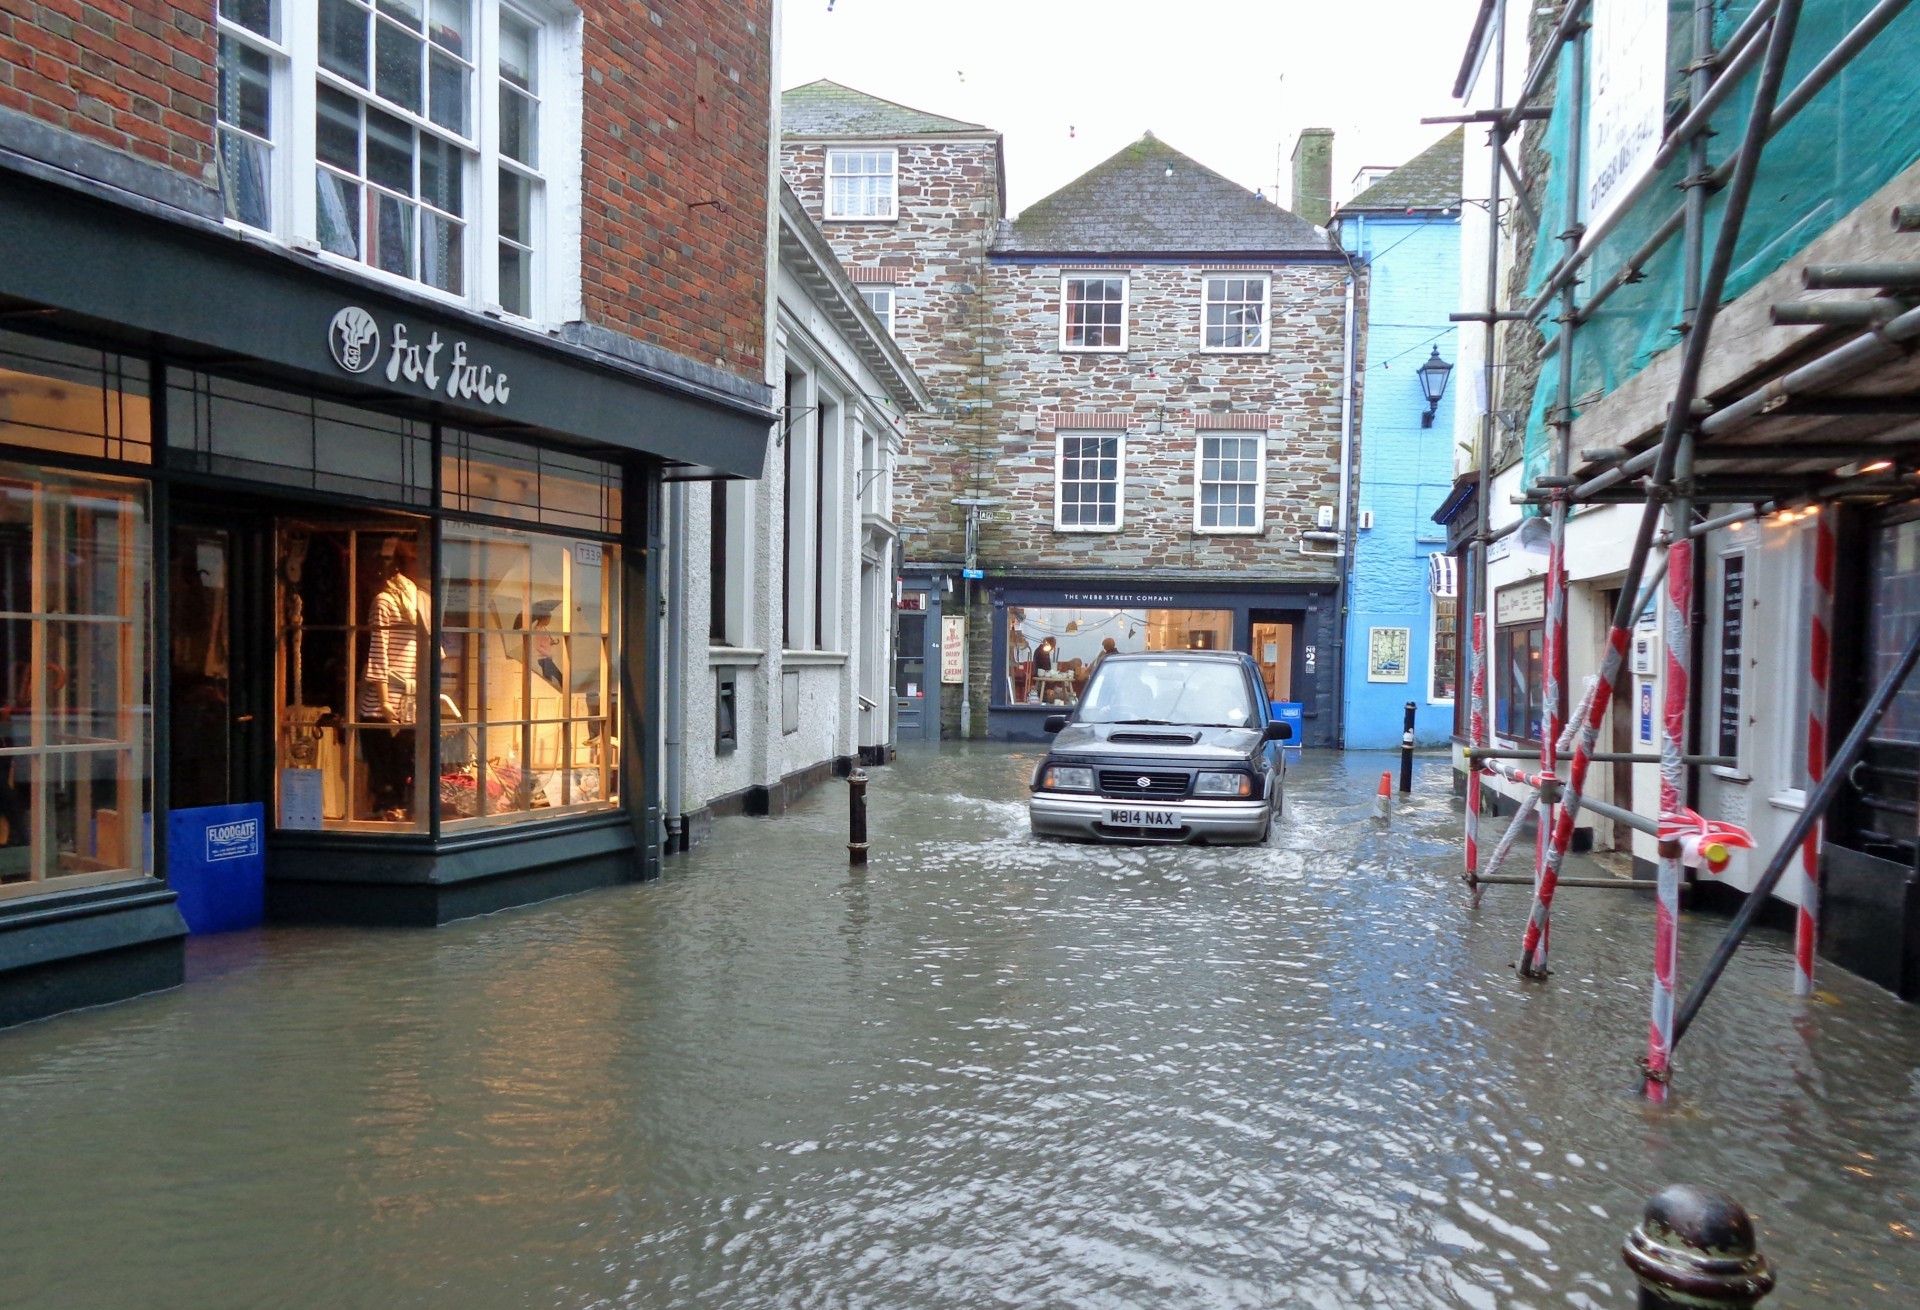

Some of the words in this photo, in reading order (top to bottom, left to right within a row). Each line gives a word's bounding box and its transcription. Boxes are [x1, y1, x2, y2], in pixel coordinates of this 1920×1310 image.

[386, 322, 444, 391] fat
[446, 341, 510, 405] face
[1305, 652, 1316, 665] 2
[1110, 809, 1141, 824] W814
[1145, 811, 1174, 825] NAX
[208, 822, 256, 842] FLOODGATE
